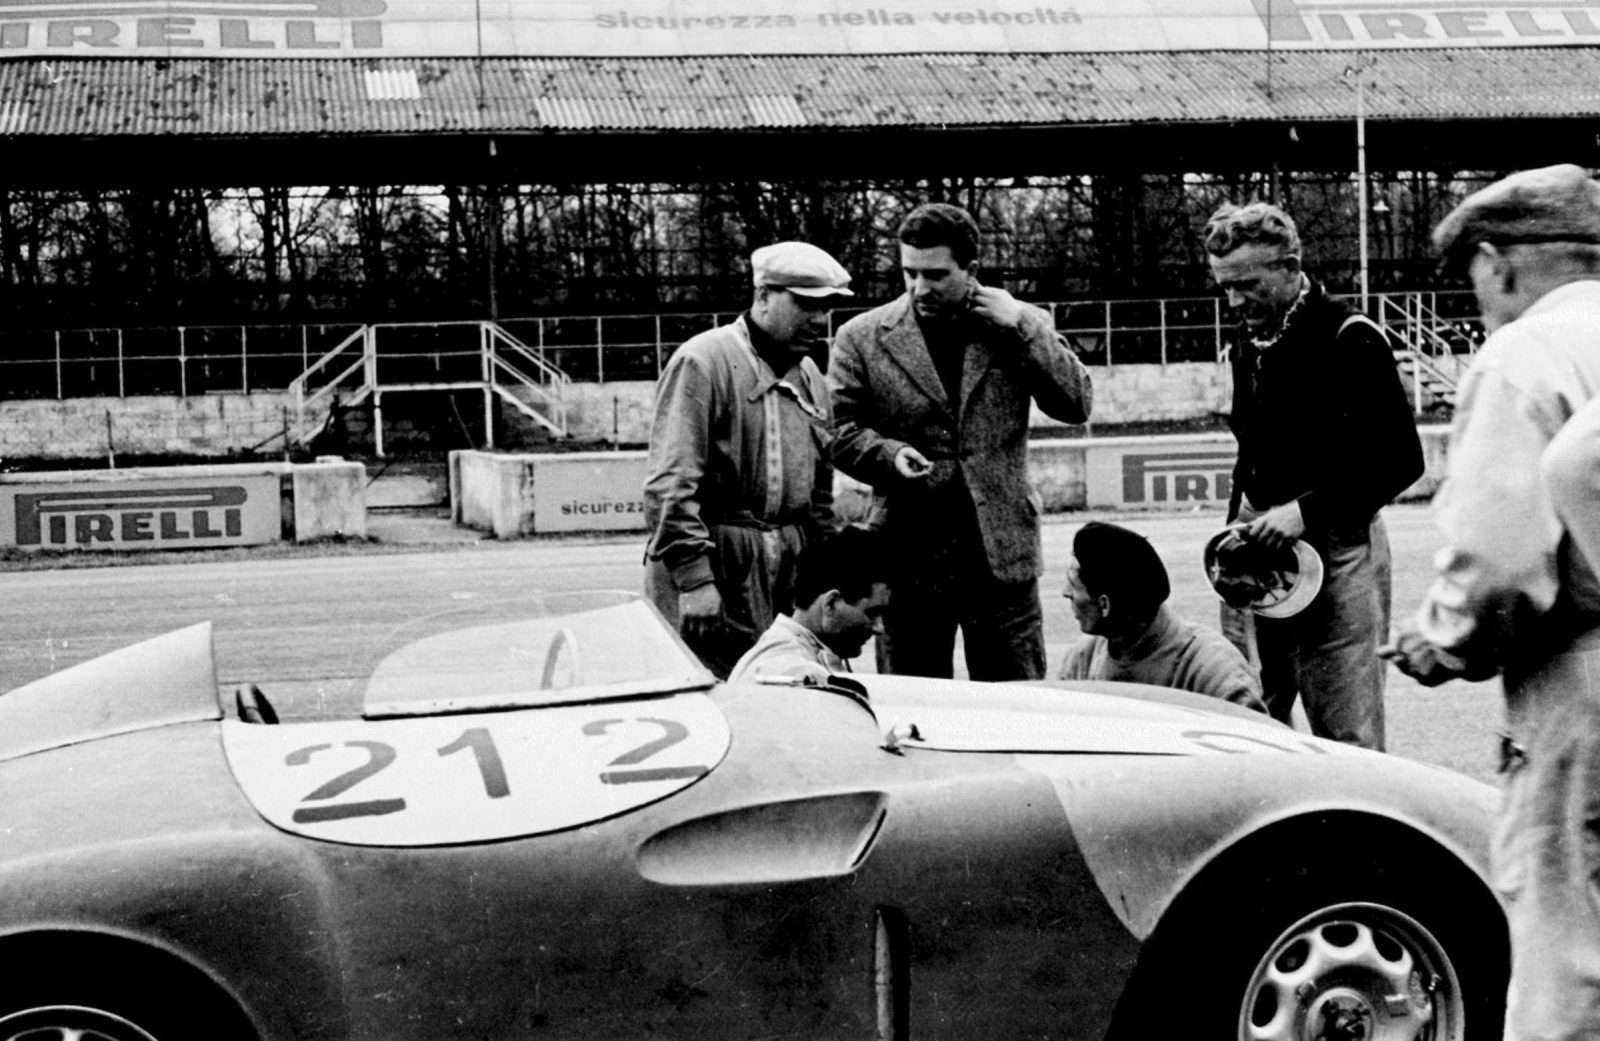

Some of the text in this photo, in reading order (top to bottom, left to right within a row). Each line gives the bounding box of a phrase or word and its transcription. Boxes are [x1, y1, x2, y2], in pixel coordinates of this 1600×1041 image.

[0, 0, 388, 49] IRELLI
[817, 9, 916, 26] nella
[1252, 0, 1600, 41] PIRELL
[1122, 452, 1238, 503] PIRE
[14, 486, 248, 545] PIRELLI
[561, 500, 645, 515] sicurezz
[284, 718, 709, 824] 212
